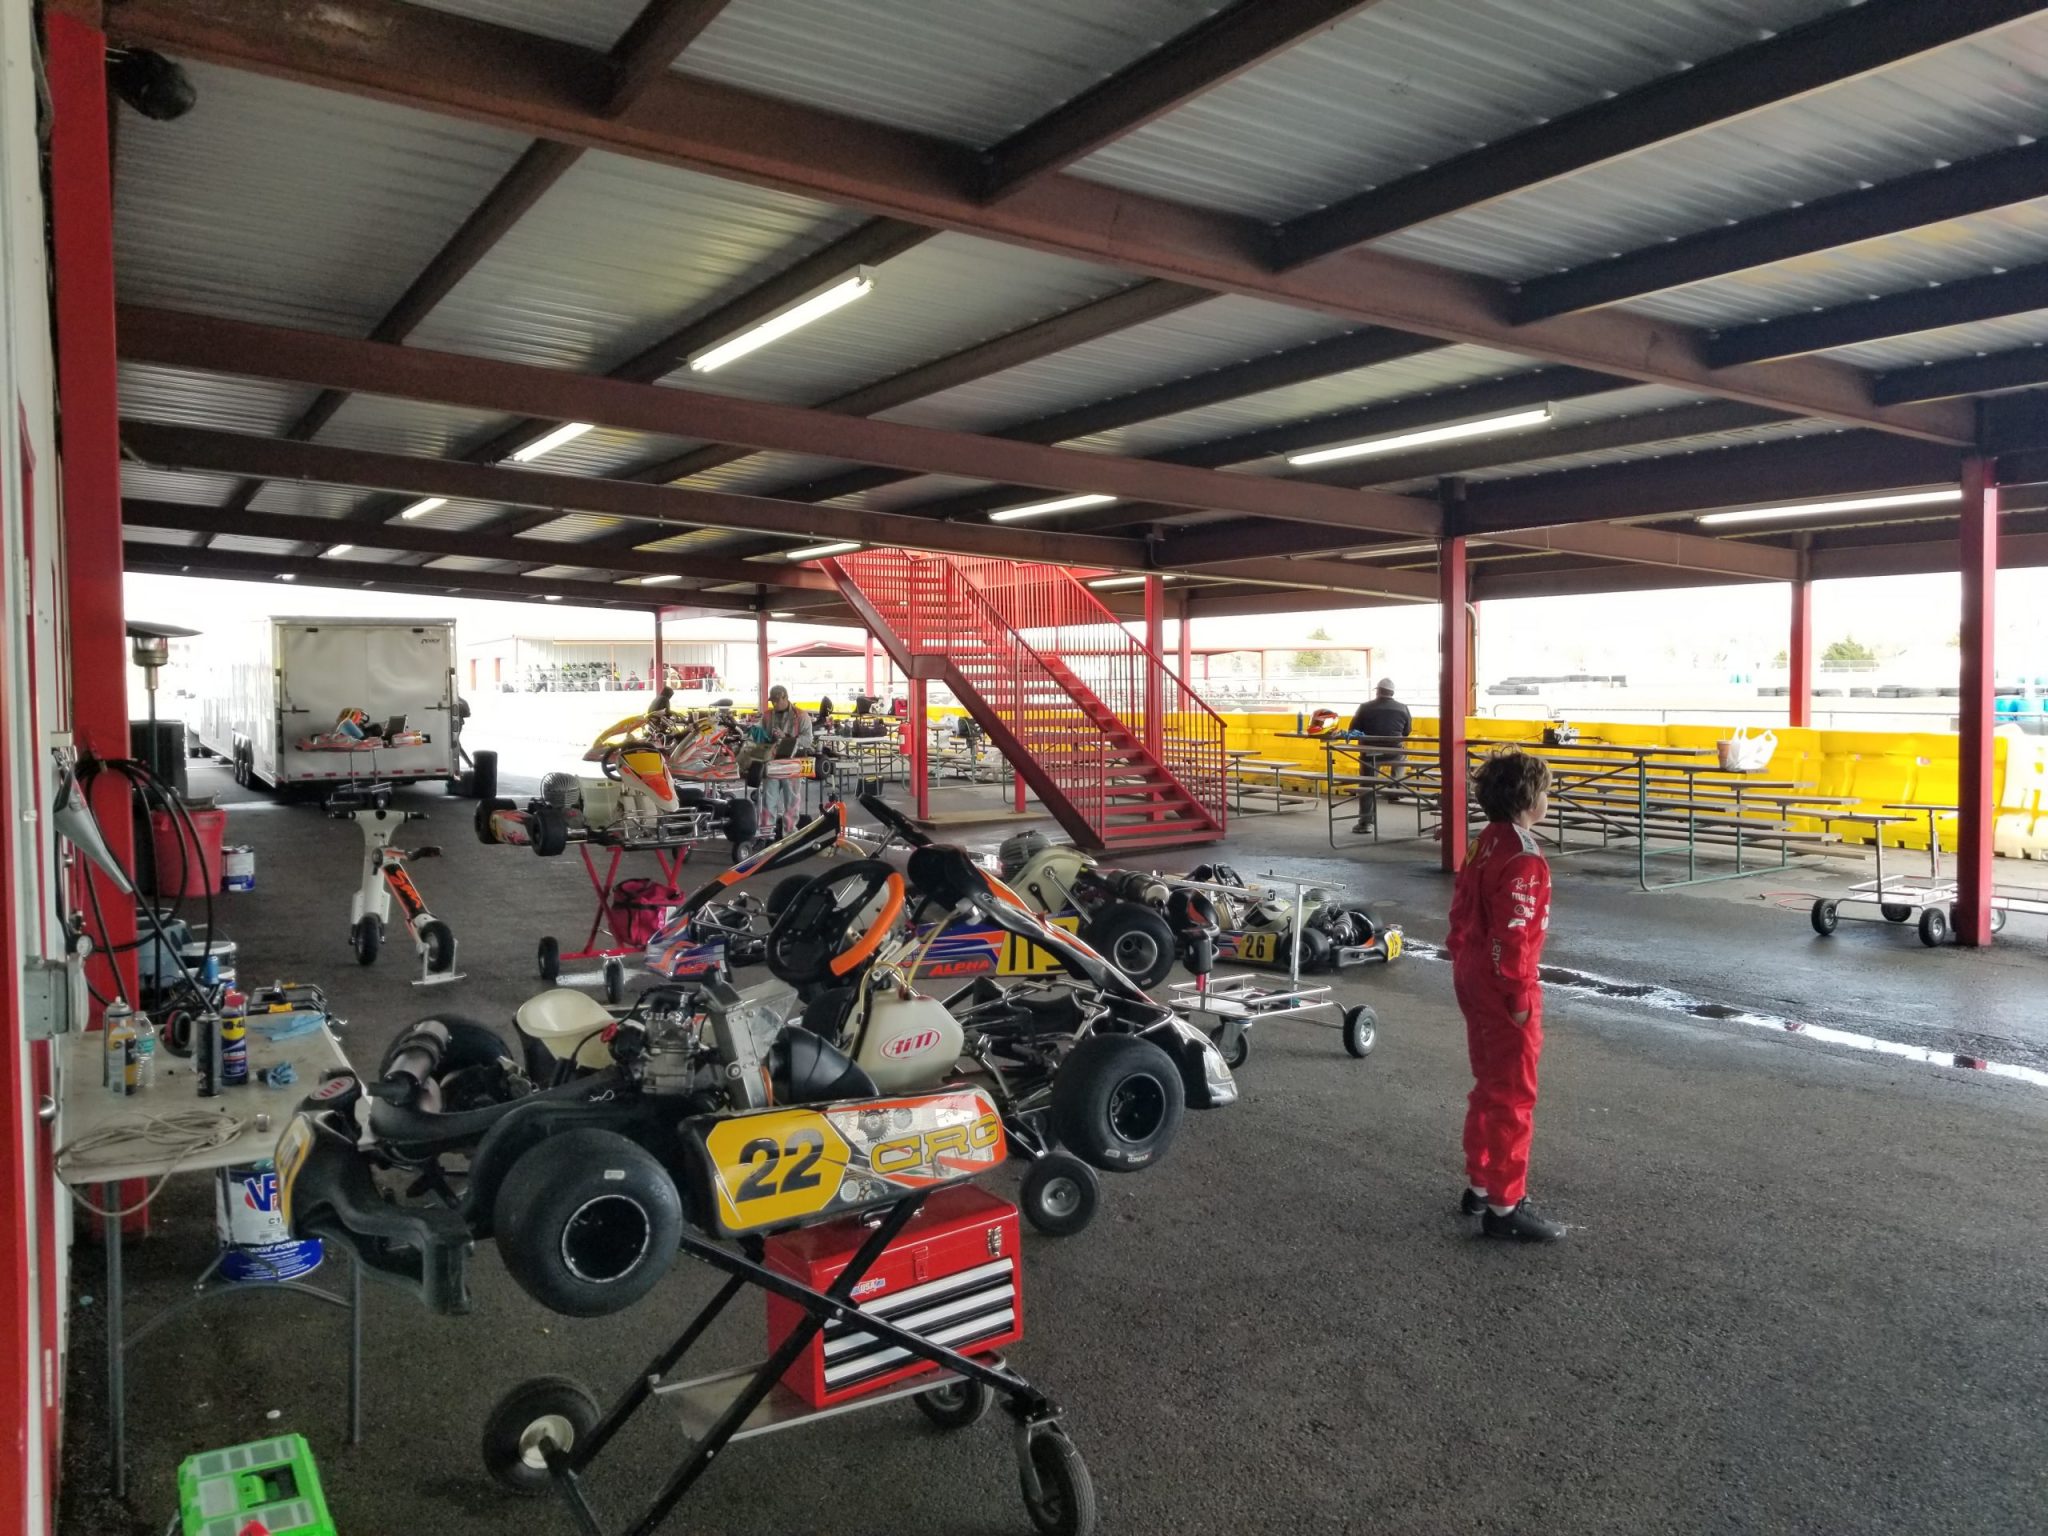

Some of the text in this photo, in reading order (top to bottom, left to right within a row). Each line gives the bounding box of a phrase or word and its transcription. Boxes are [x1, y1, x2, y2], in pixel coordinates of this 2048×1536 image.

[929, 959, 990, 977] ALPHA
[1245, 935, 1265, 959] 26
[736, 1128, 824, 1203] 22
[870, 1113, 999, 1175] CRG
